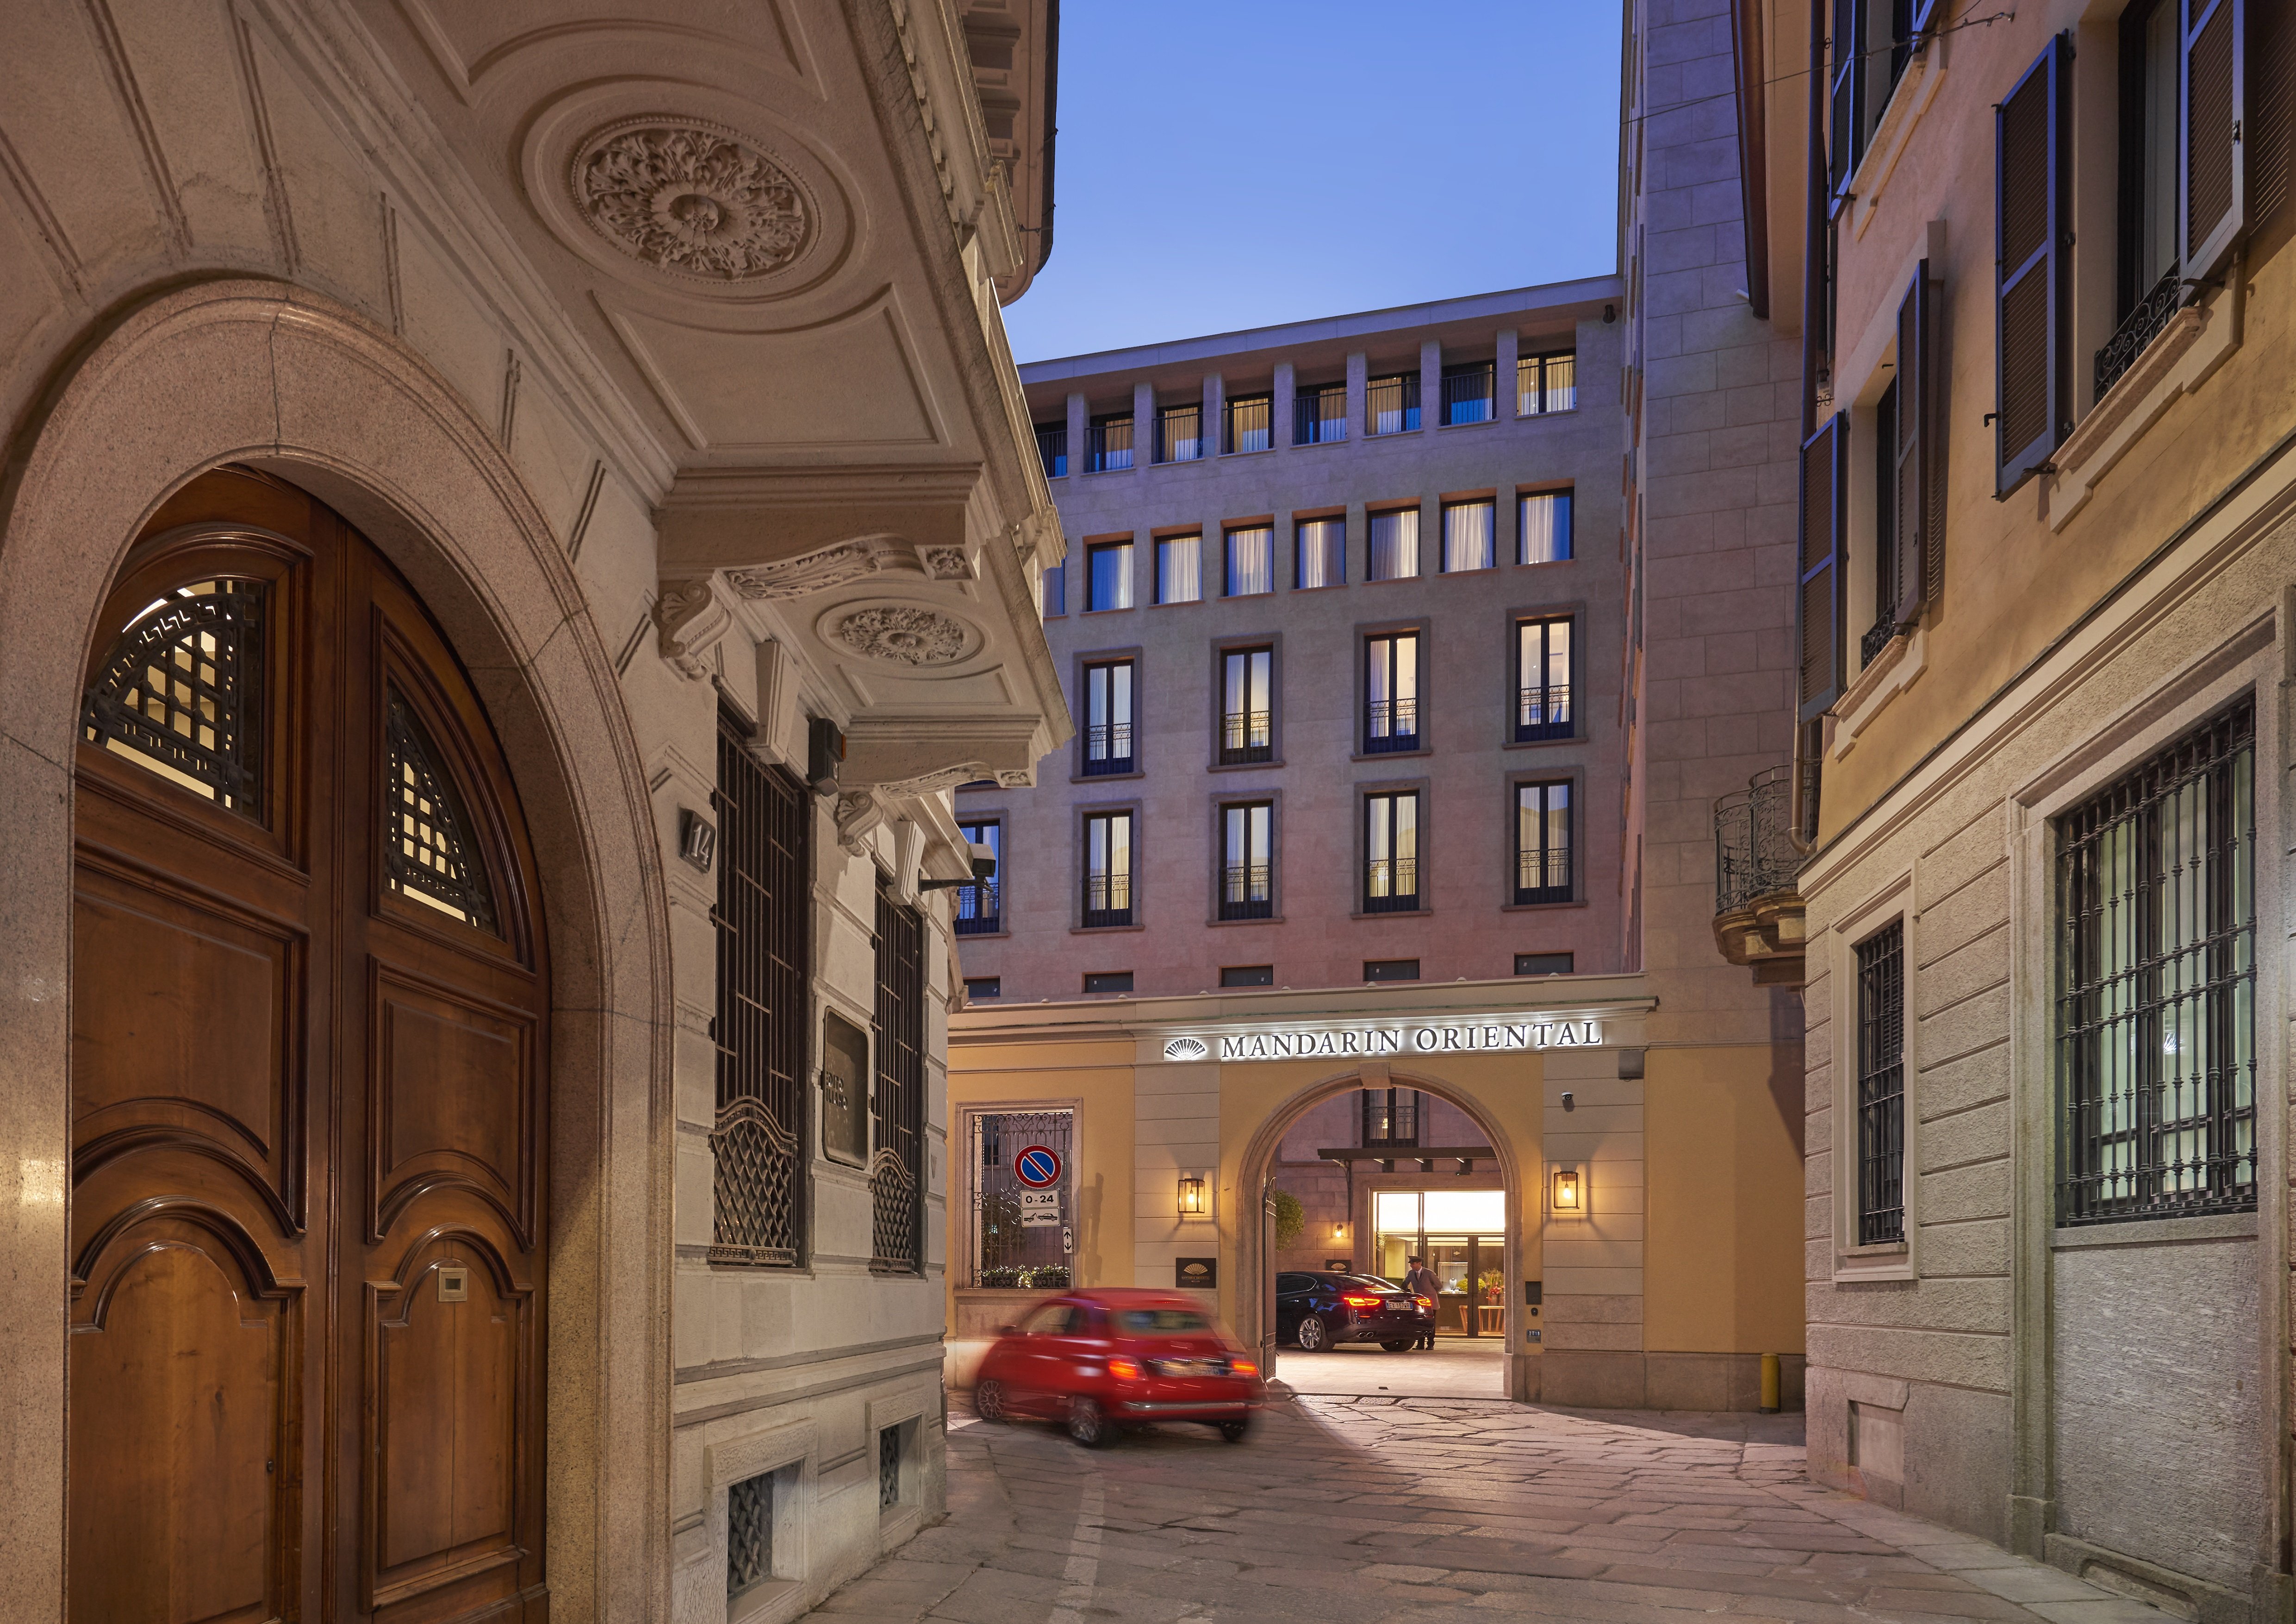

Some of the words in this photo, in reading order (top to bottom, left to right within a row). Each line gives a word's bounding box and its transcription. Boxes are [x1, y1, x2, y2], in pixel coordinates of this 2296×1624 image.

[691, 824, 711, 865] 14
[1222, 1030, 1400, 1058] MANDARIN
[1416, 1022, 1601, 1050] ORIENTAL
[1026, 1195, 1033, 1204] 0
[1039, 1194, 1054, 1203] 24
